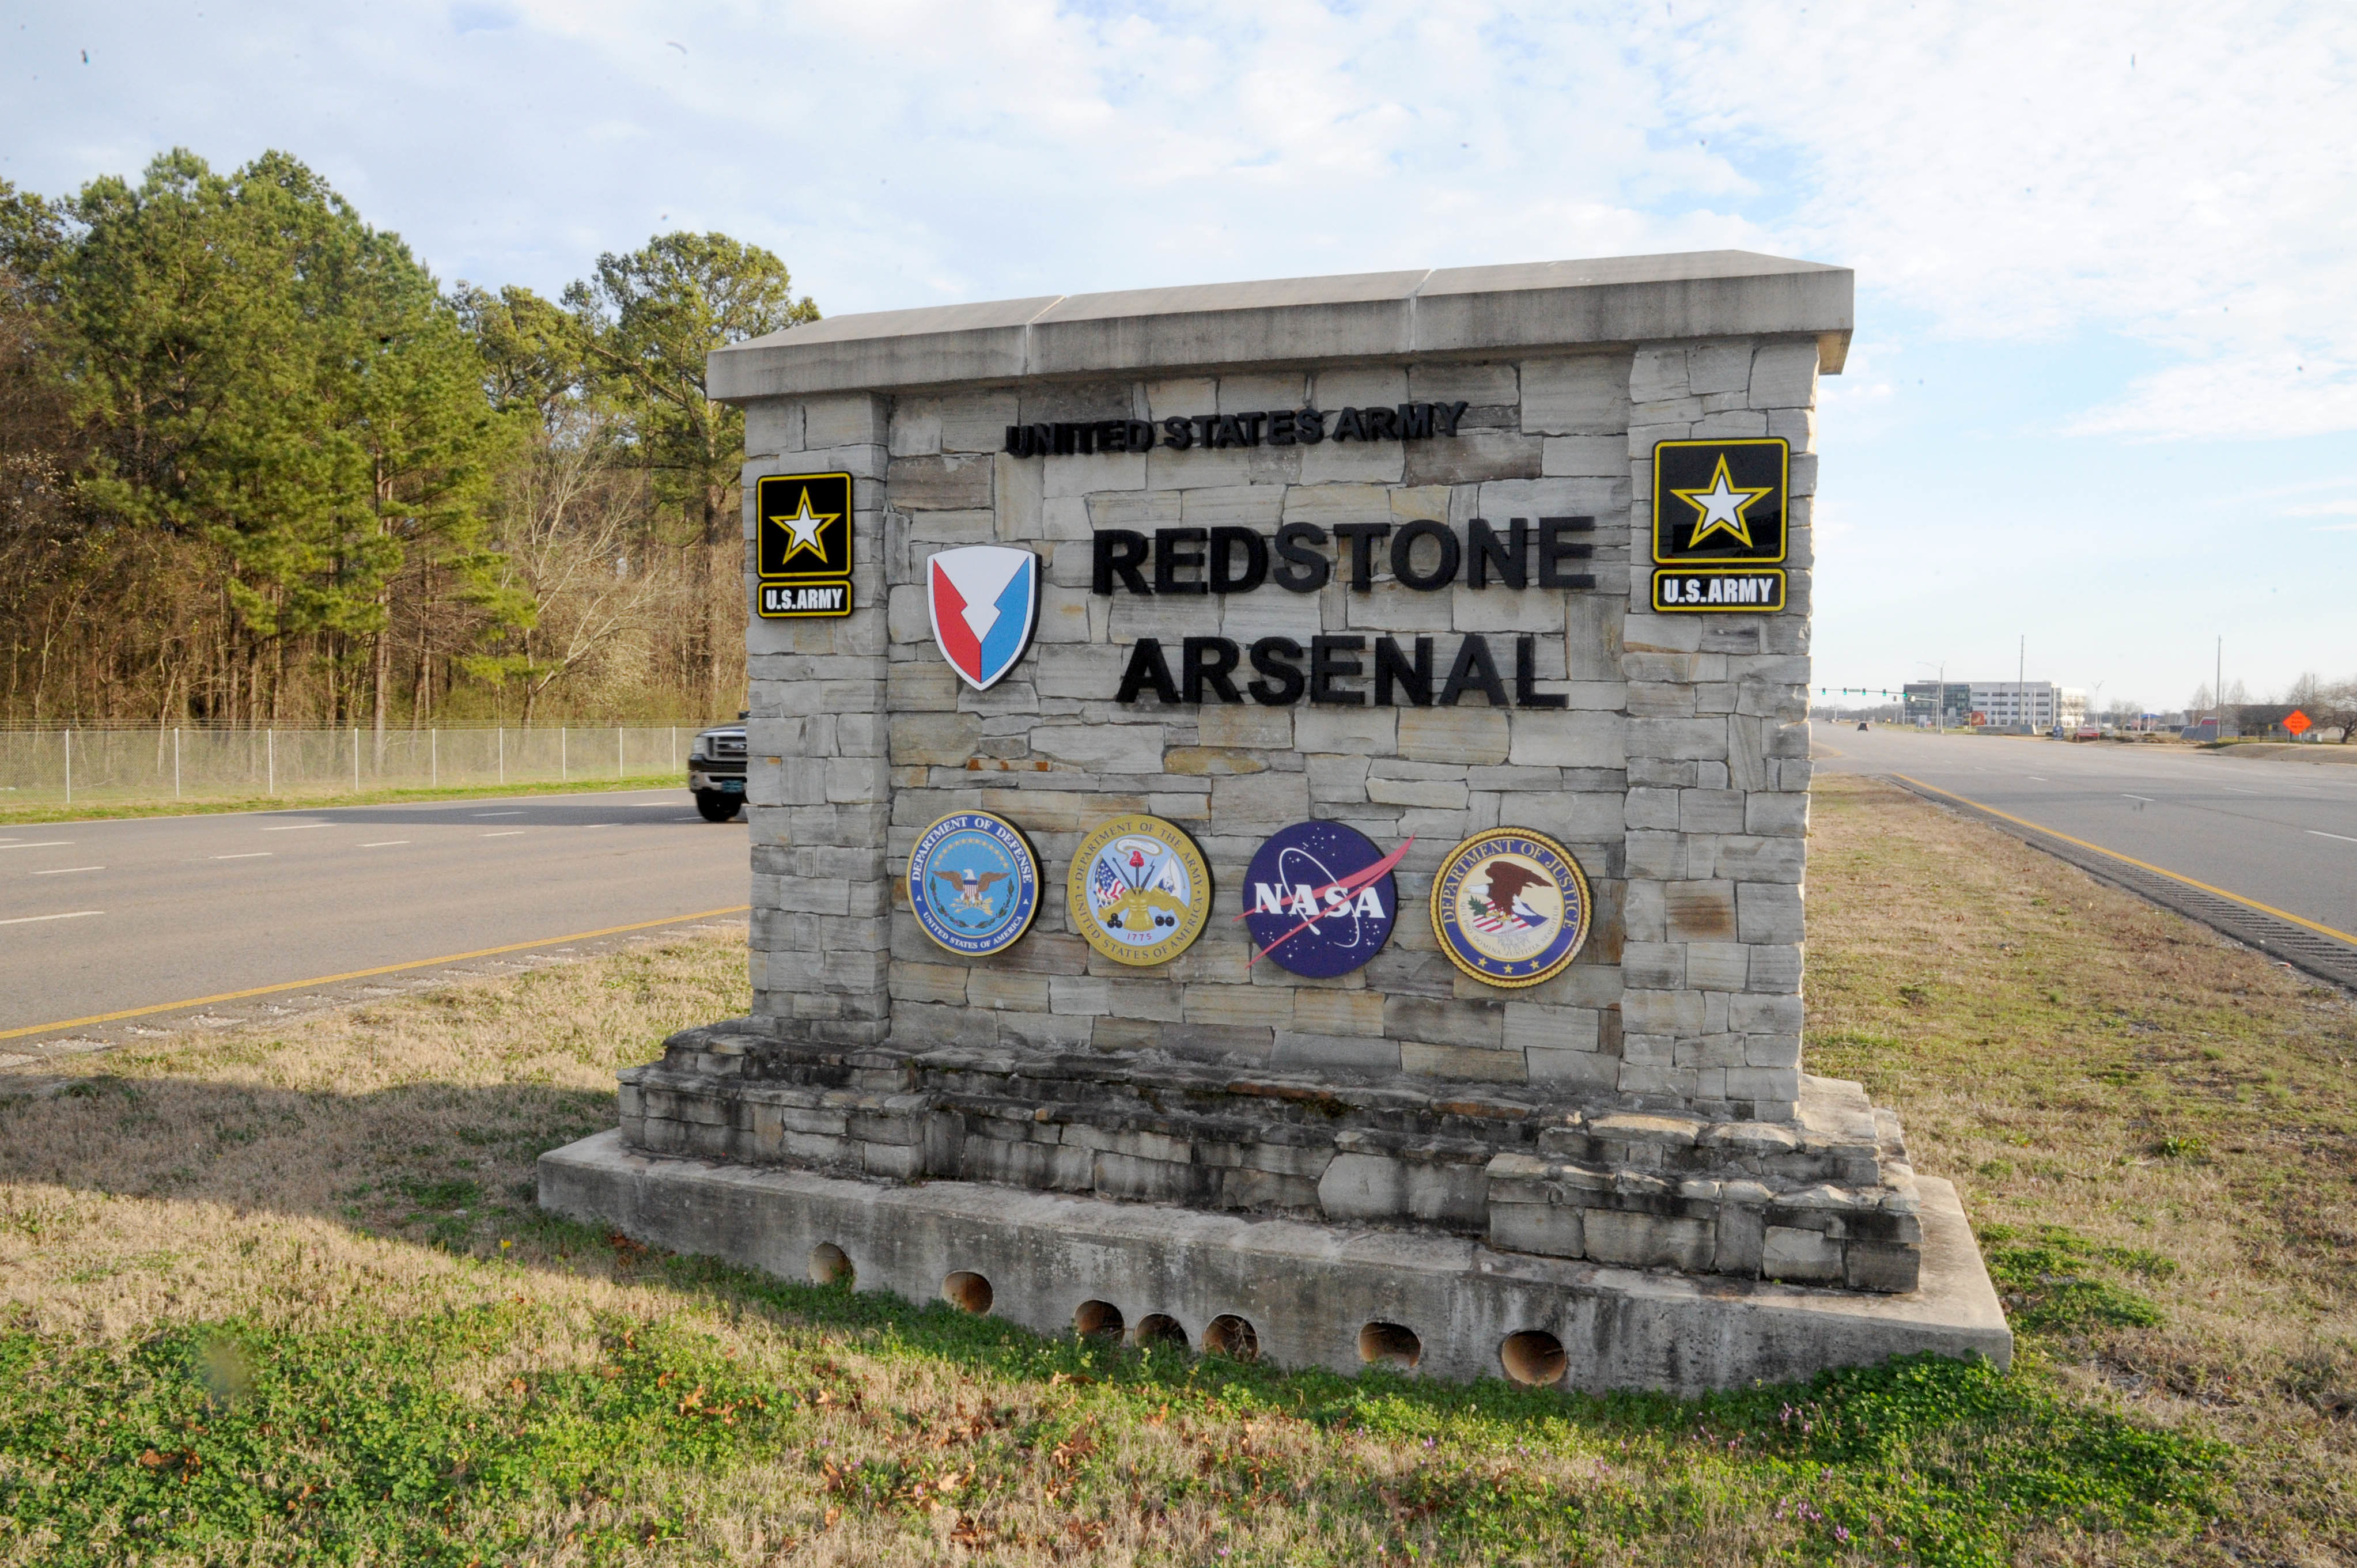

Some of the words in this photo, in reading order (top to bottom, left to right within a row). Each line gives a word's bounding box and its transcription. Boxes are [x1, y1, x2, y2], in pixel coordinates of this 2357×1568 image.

[1006, 419, 1154, 458] UNITED
[1164, 406, 1324, 450] STATES
[1332, 401, 1467, 442] ARMY
[1092, 516, 1596, 595] REDSTONE
[1115, 634, 1570, 707] ARSENAL
[911, 817, 968, 881] DEPARTMENT
[974, 817, 993, 830] OF
[996, 827, 1033, 884] DEFENSE
[1075, 822, 1132, 881] DEPARTMENT
[1140, 822, 1155, 832] OF
[1160, 828, 1182, 847] THE
[1182, 852, 1203, 887] ARMY
[1254, 882, 1386, 918] NASA
[1443, 839, 1516, 923] DEPARTMENT
[1520, 842, 1546, 859] OF
[1545, 858, 1579, 930] JUSTICE
[923, 911, 949, 940] UNITED
[949, 937, 978, 949] STATES
[980, 940, 992, 949] OF
[993, 916, 1023, 945] AMERICA
[1075, 893, 1100, 940] UNITED
[1102, 940, 1148, 959] STATES
[1153, 945, 1168, 957] OF
[1170, 896, 1203, 950] AMERICA
[1126, 933, 1152, 941] 1775
